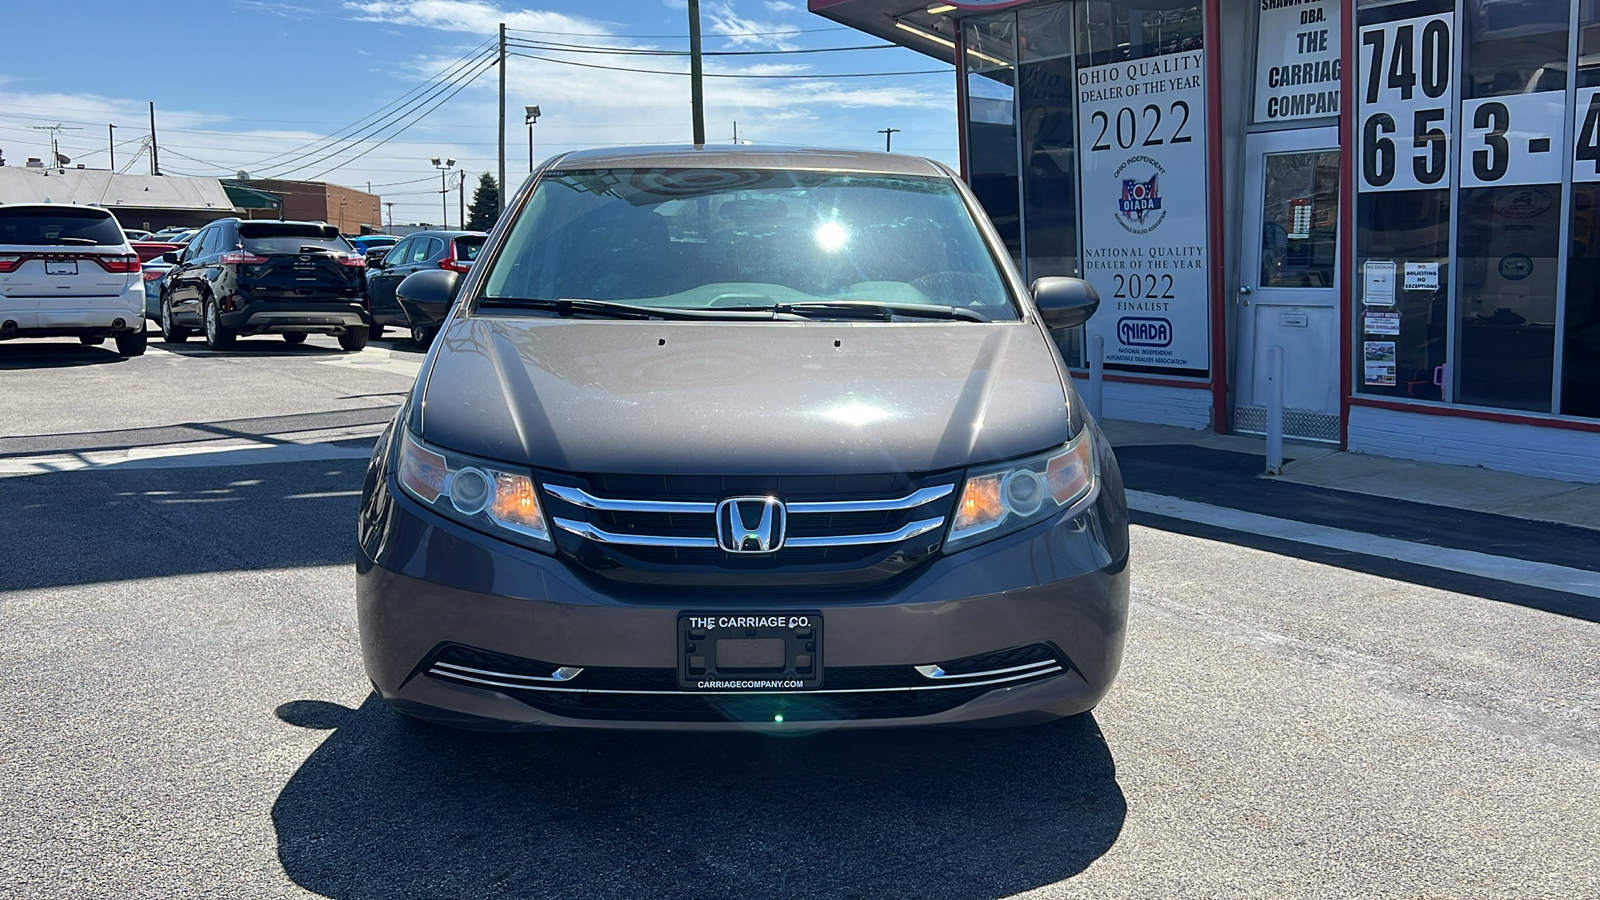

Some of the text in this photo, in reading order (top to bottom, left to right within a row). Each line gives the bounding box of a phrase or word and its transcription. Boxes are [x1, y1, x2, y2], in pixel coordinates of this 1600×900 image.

[1300, 8, 1326, 25] DBA.
[1296, 29, 1328, 54] THE
[1079, 54, 1203, 86] OHIO QUALITY
[1363, 19, 1450, 104] 740
[1081, 87, 1123, 103] DEALER
[1126, 84, 1140, 97] OF
[1142, 80, 1166, 94] THE
[1169, 75, 1200, 91] YEAR
[1267, 90, 1341, 118] COMPAN
[1091, 100, 1192, 152] 2022
[1114, 156, 1166, 178] OHIO INDEPENDENT
[1124, 198, 1154, 210] OIADA
[1086, 246, 1203, 258] NATIONAL QUALITY
[1086, 260, 1202, 269] DEALER OF THE YEAR
[1113, 274, 1175, 299] 2022
[1117, 302, 1170, 312] FINALIST
[1121, 323, 1167, 341] NIADA
[690, 616, 812, 628] THE CARRIAGE CO.
